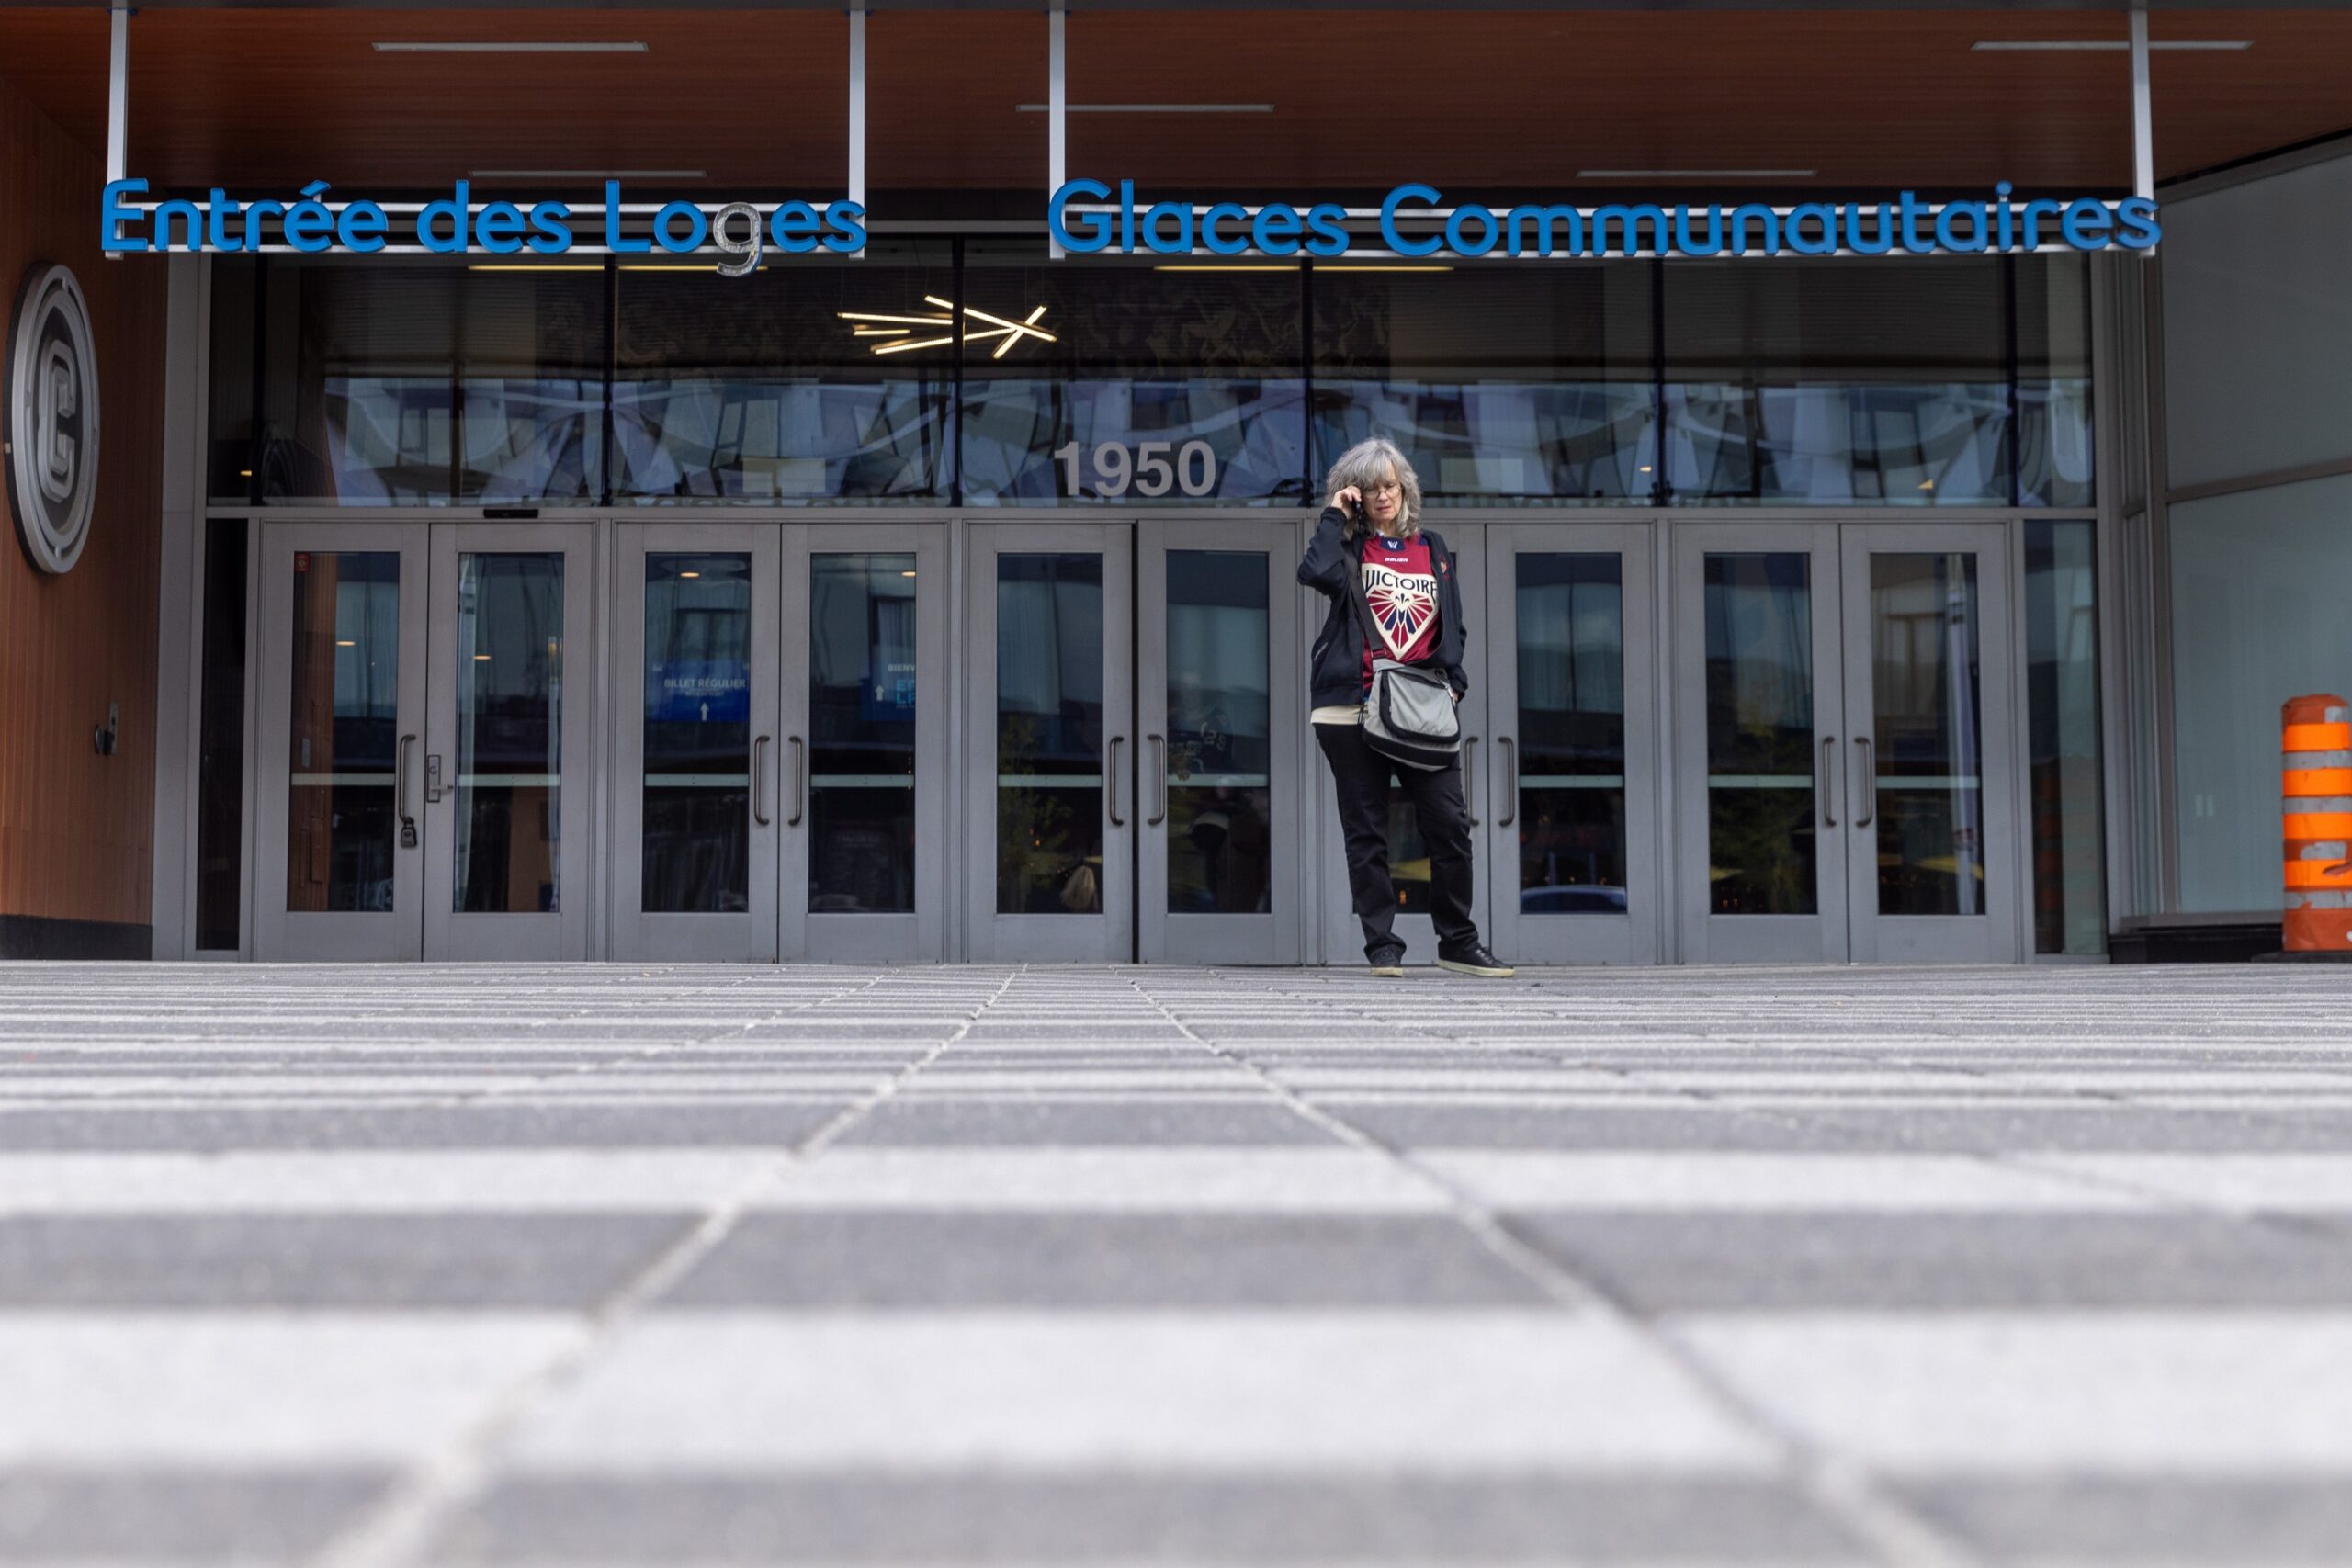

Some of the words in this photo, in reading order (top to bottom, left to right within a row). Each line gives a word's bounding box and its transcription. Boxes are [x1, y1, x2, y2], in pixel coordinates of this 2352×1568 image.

[101, 177, 389, 254] Entrée
[415, 179, 573, 254] des
[605, 179, 867, 276] Loges
[1047, 178, 1351, 257] Glaces
[1379, 181, 2162, 257] Communautaires
[1054, 440, 1216, 497] 1950
[1365, 570, 1438, 604] VICTOIRE
[663, 678, 695, 688] BILLET
[698, 676, 746, 688] RÉGULIER
